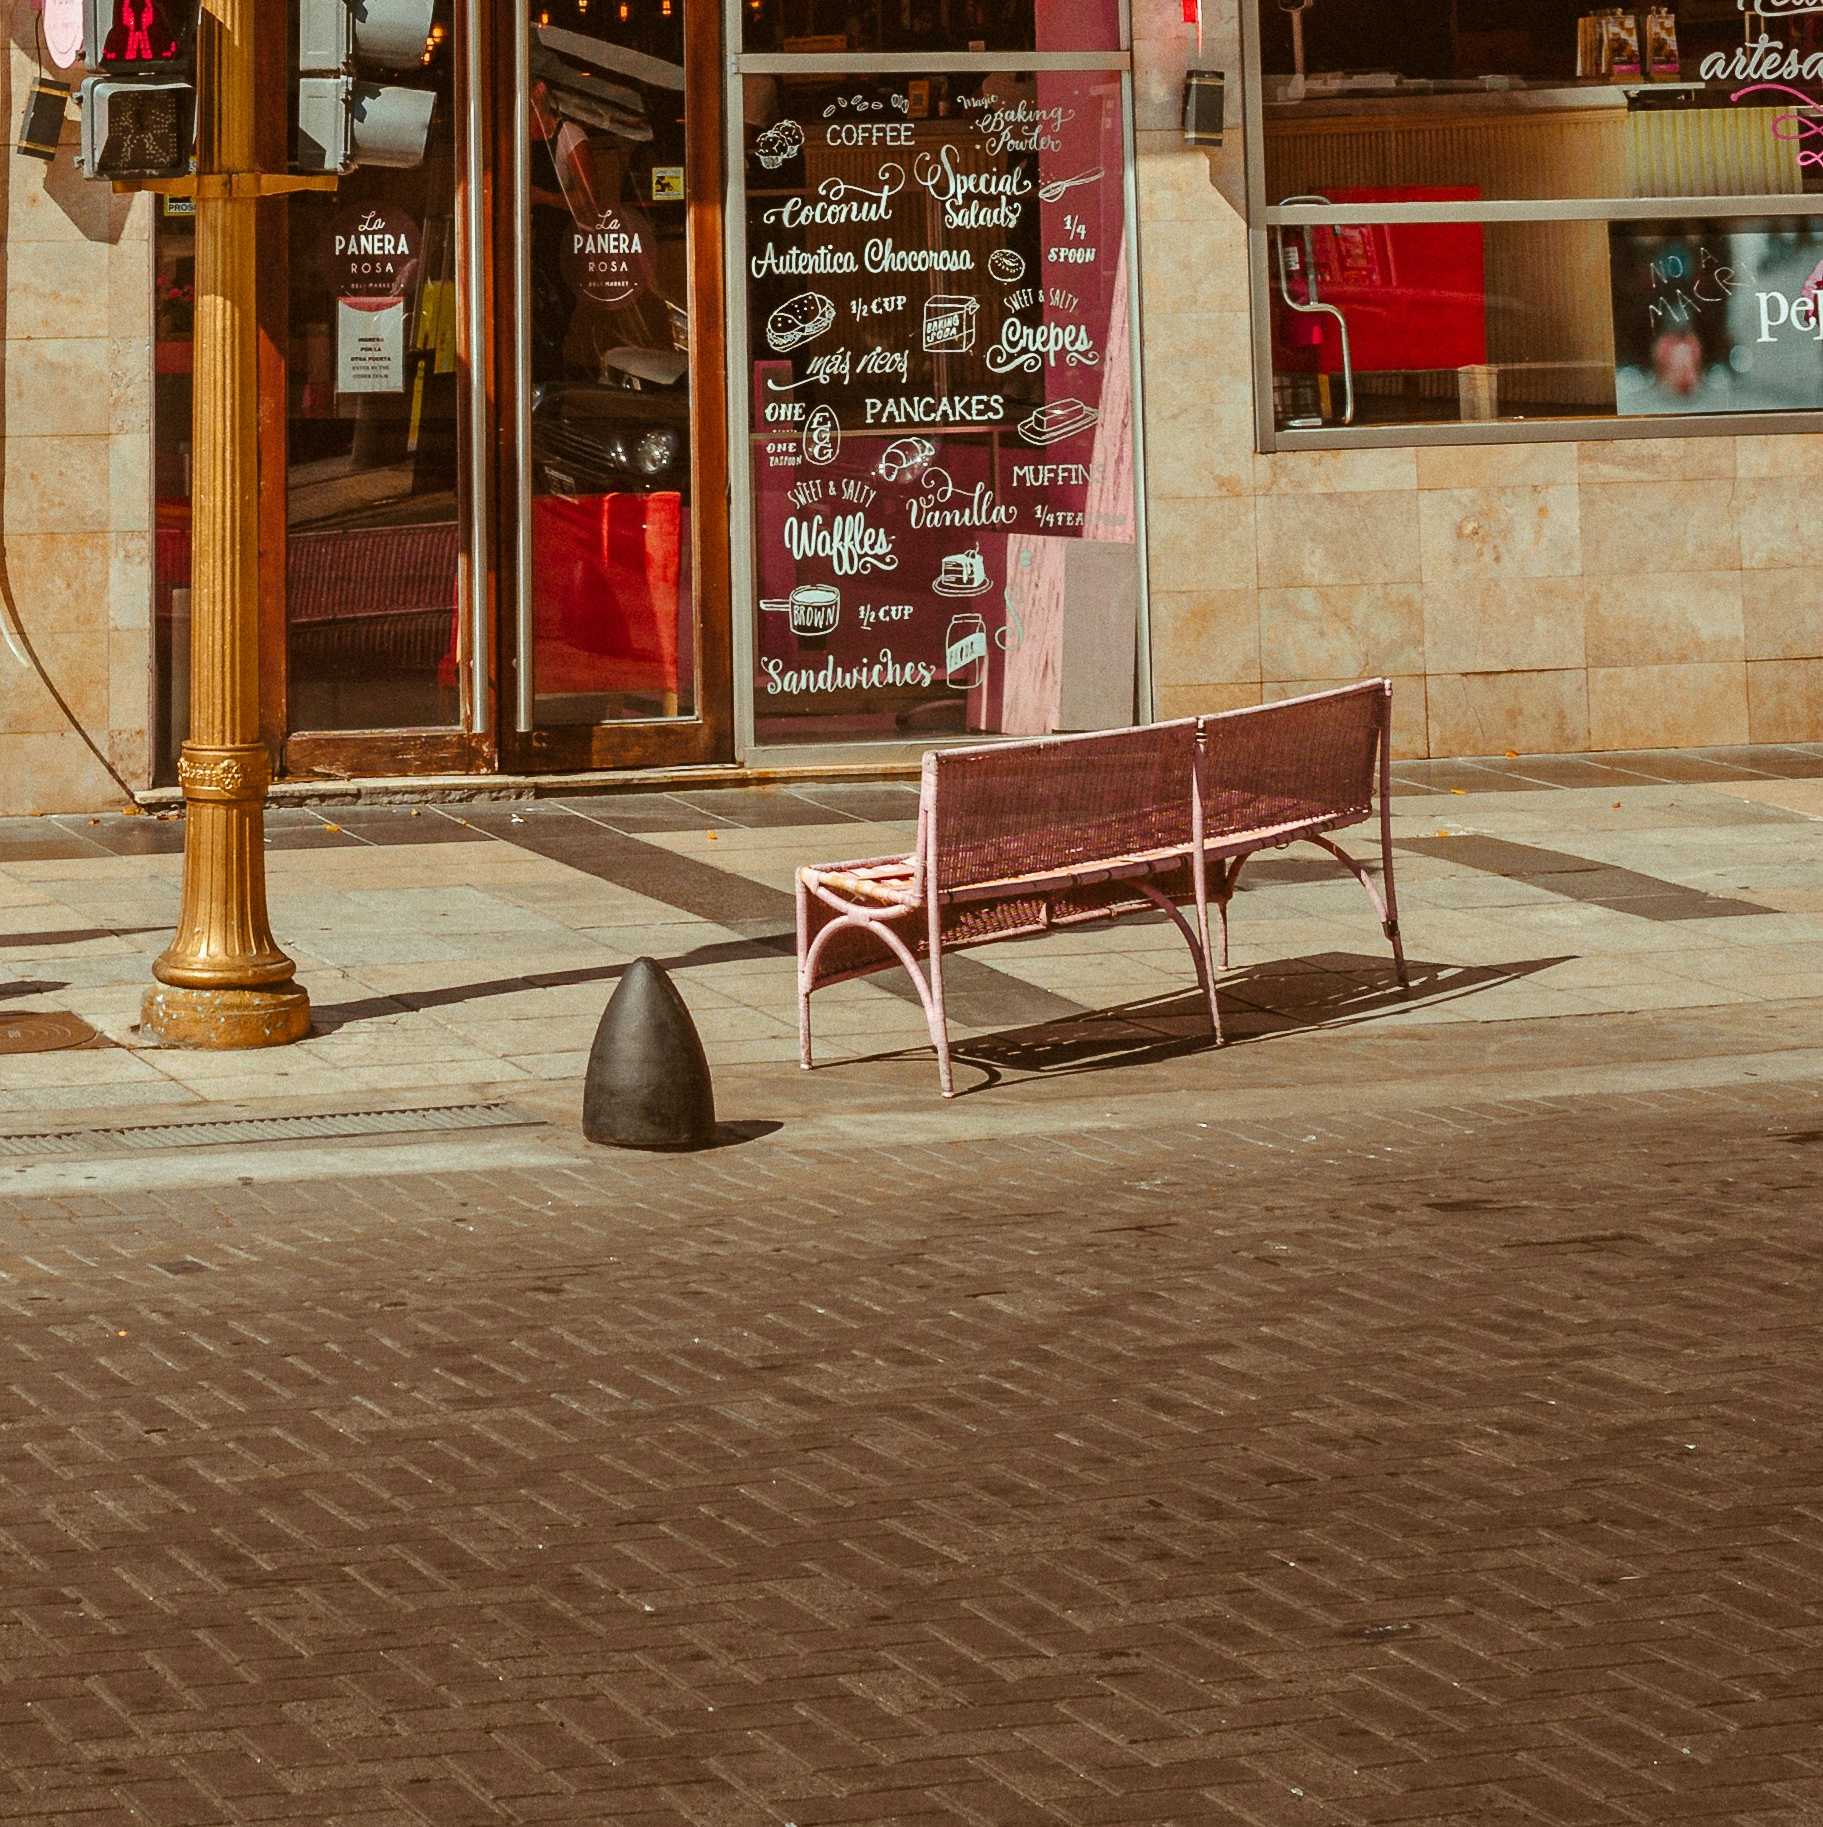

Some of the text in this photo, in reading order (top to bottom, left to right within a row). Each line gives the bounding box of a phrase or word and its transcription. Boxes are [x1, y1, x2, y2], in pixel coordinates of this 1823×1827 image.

[956, 94, 1000, 109] Magic
[975, 100, 1075, 133] Baking
[826, 123, 915, 146] COFFEE
[986, 125, 1062, 156] Powder
[915, 145, 1031, 206] Special
[765, 176, 903, 229] Coconut
[944, 195, 1022, 229] Salads
[357, 210, 386, 232] La
[595, 209, 621, 230] La
[334, 233, 410, 256] PANERA
[573, 232, 643, 254] PANERA
[1047, 247, 1097, 264] SPOON
[350, 262, 394, 274] ROSA
[588, 260, 629, 272] ROSA
[751, 238, 975, 279] Autentica Chocorosa
[1649, 246, 1719, 288] NO A
[870, 295, 907, 315] CUP
[1003, 287, 1080, 314] SWEET & SALTY
[926, 313, 960, 334] BAKING
[926, 327, 958, 343] SODA
[1000, 316, 1095, 368] Crepes
[788, 346, 852, 387] más
[764, 402, 806, 422] ONE
[864, 395, 1005, 423] PANCAKES
[766, 442, 798, 454] ONE
[810, 411, 833, 461] EGG
[786, 478, 878, 510] SWEET & SALTY
[905, 477, 1018, 530] Vanilla
[783, 511, 894, 576] Waffles
[793, 604, 837, 629] BROWN
[878, 604, 915, 622] CUP
[760, 647, 937, 695] Sandwiches
